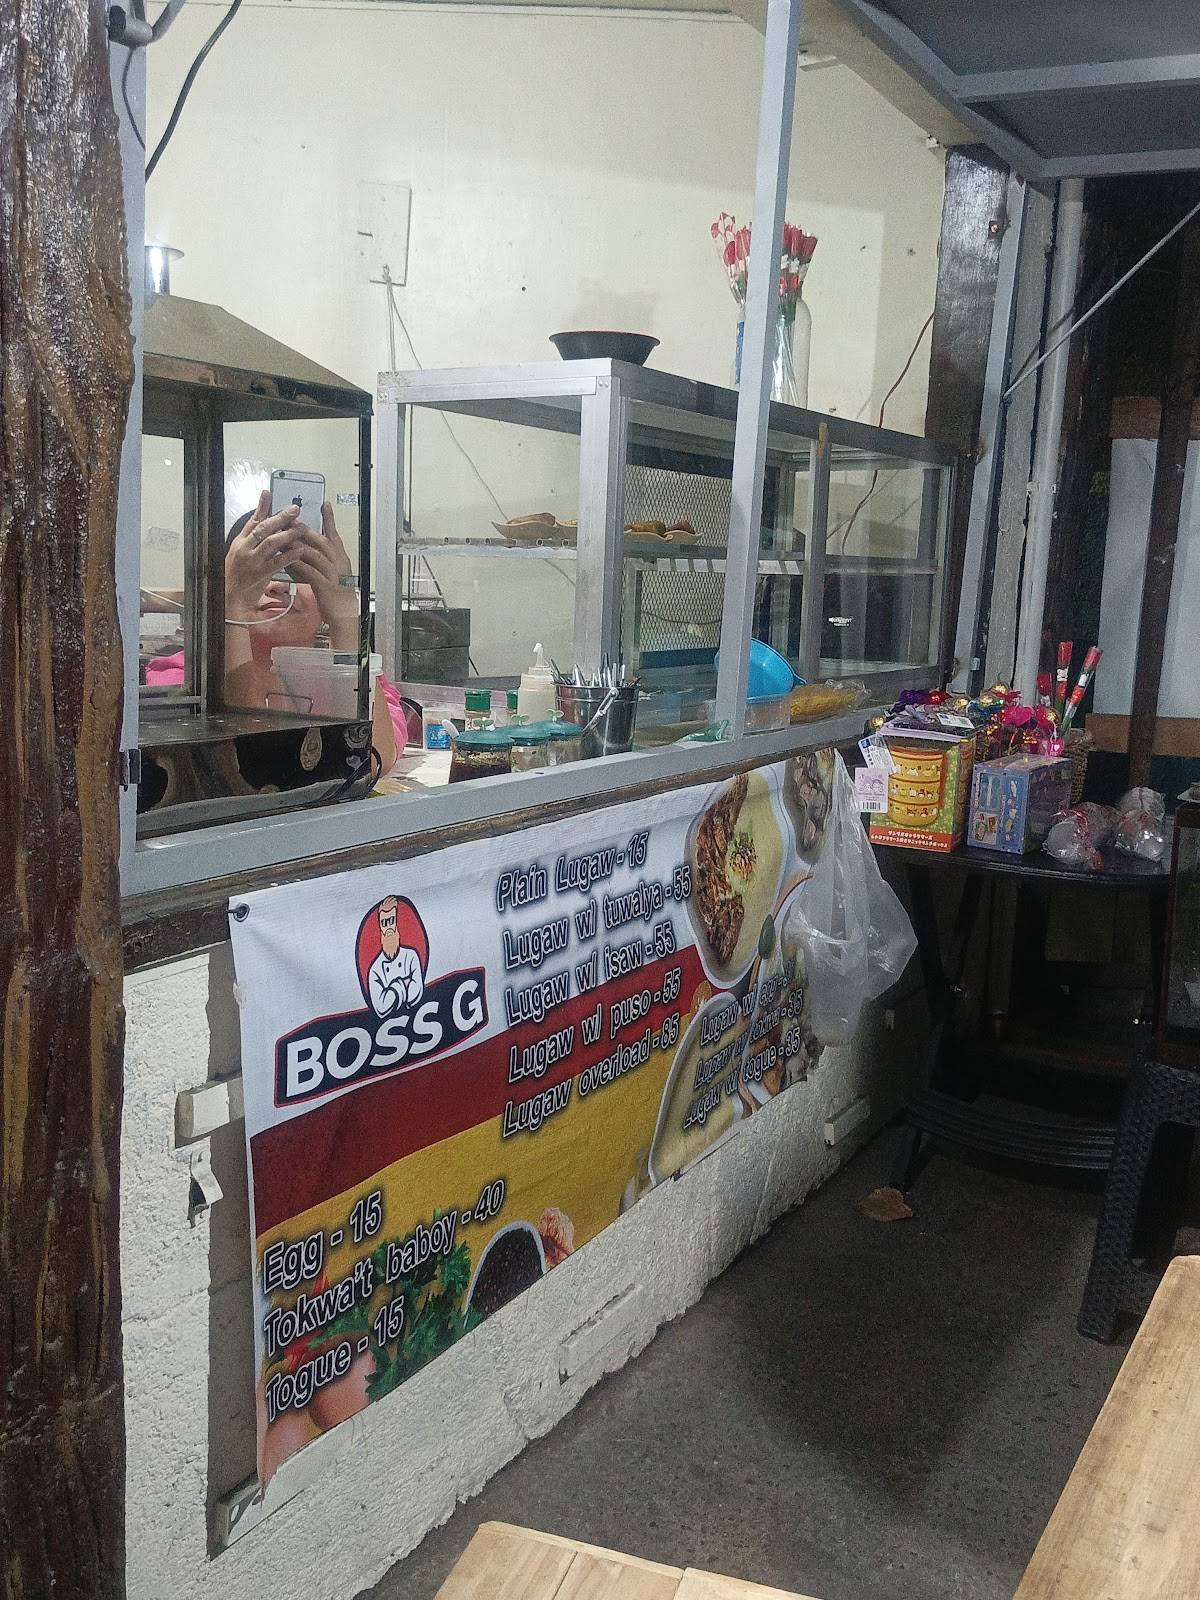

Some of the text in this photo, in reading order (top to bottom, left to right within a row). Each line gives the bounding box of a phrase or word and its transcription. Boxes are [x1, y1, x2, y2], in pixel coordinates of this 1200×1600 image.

[497, 865, 547, 912] Plain
[555, 848, 616, 892] Lugaw
[628, 832, 649, 867] 15
[503, 918, 568, 970] Lugaw
[575, 899, 598, 940] w/
[603, 881, 663, 930] tuwalya
[673, 865, 692, 901] 55
[504, 971, 569, 1027] Lugaw
[575, 952, 598, 993] w/
[604, 939, 642, 981] isaw
[654, 921, 676, 958] 55
[508, 1026, 574, 1083] Lugaw
[581, 1003, 602, 1045] w/
[610, 989, 651, 1039] puso
[663, 967, 682, 1004] 55
[701, 1000, 739, 1046] Lugaw
[286, 979, 484, 1098] BOSS G
[502, 1079, 572, 1138] Lugaw
[578, 1028, 651, 1096] overload
[661, 1012, 680, 1049] 85
[742, 1045, 777, 1083] togue
[785, 1026, 801, 1057] 35
[263, 1231, 323, 1294] Egg
[350, 1190, 382, 1243] 15
[263, 1257, 373, 1358] Tokwa't
[385, 1211, 457, 1284] baboy
[475, 1179, 505, 1222] 40
[265, 1341, 351, 1423] Togue
[374, 1295, 405, 1347] 15
